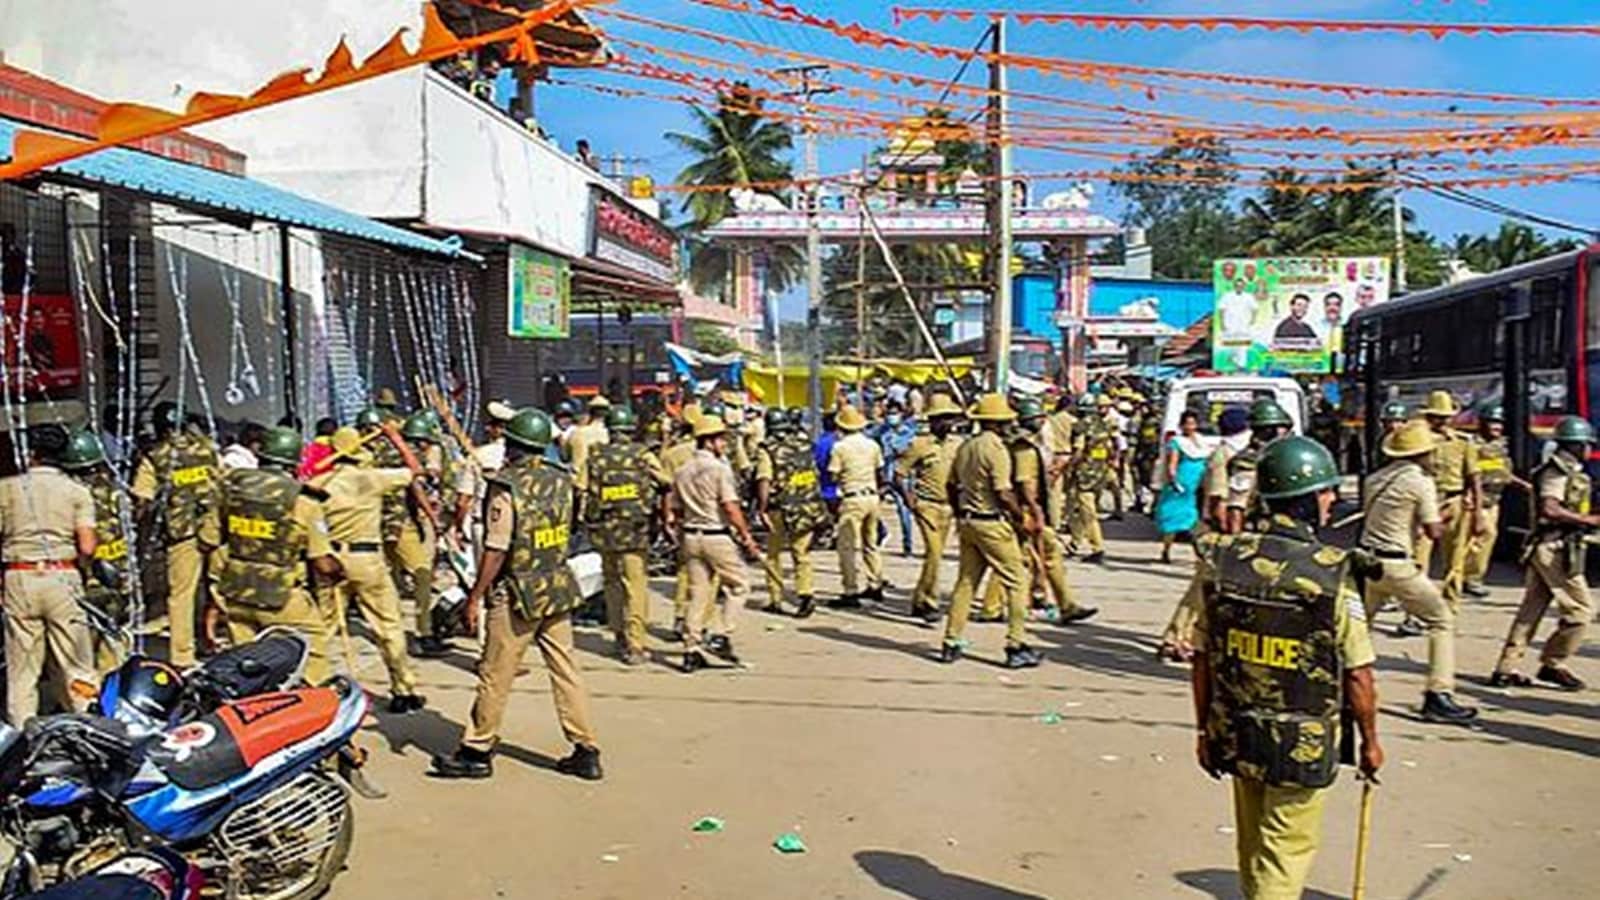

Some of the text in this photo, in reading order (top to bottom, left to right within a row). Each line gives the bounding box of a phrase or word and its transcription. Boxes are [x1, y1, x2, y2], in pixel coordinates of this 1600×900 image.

[171, 465, 209, 487] POLICE
[601, 483, 639, 501] POLICE
[228, 515, 277, 540] POLICE
[1227, 628, 1301, 670] POLICE
